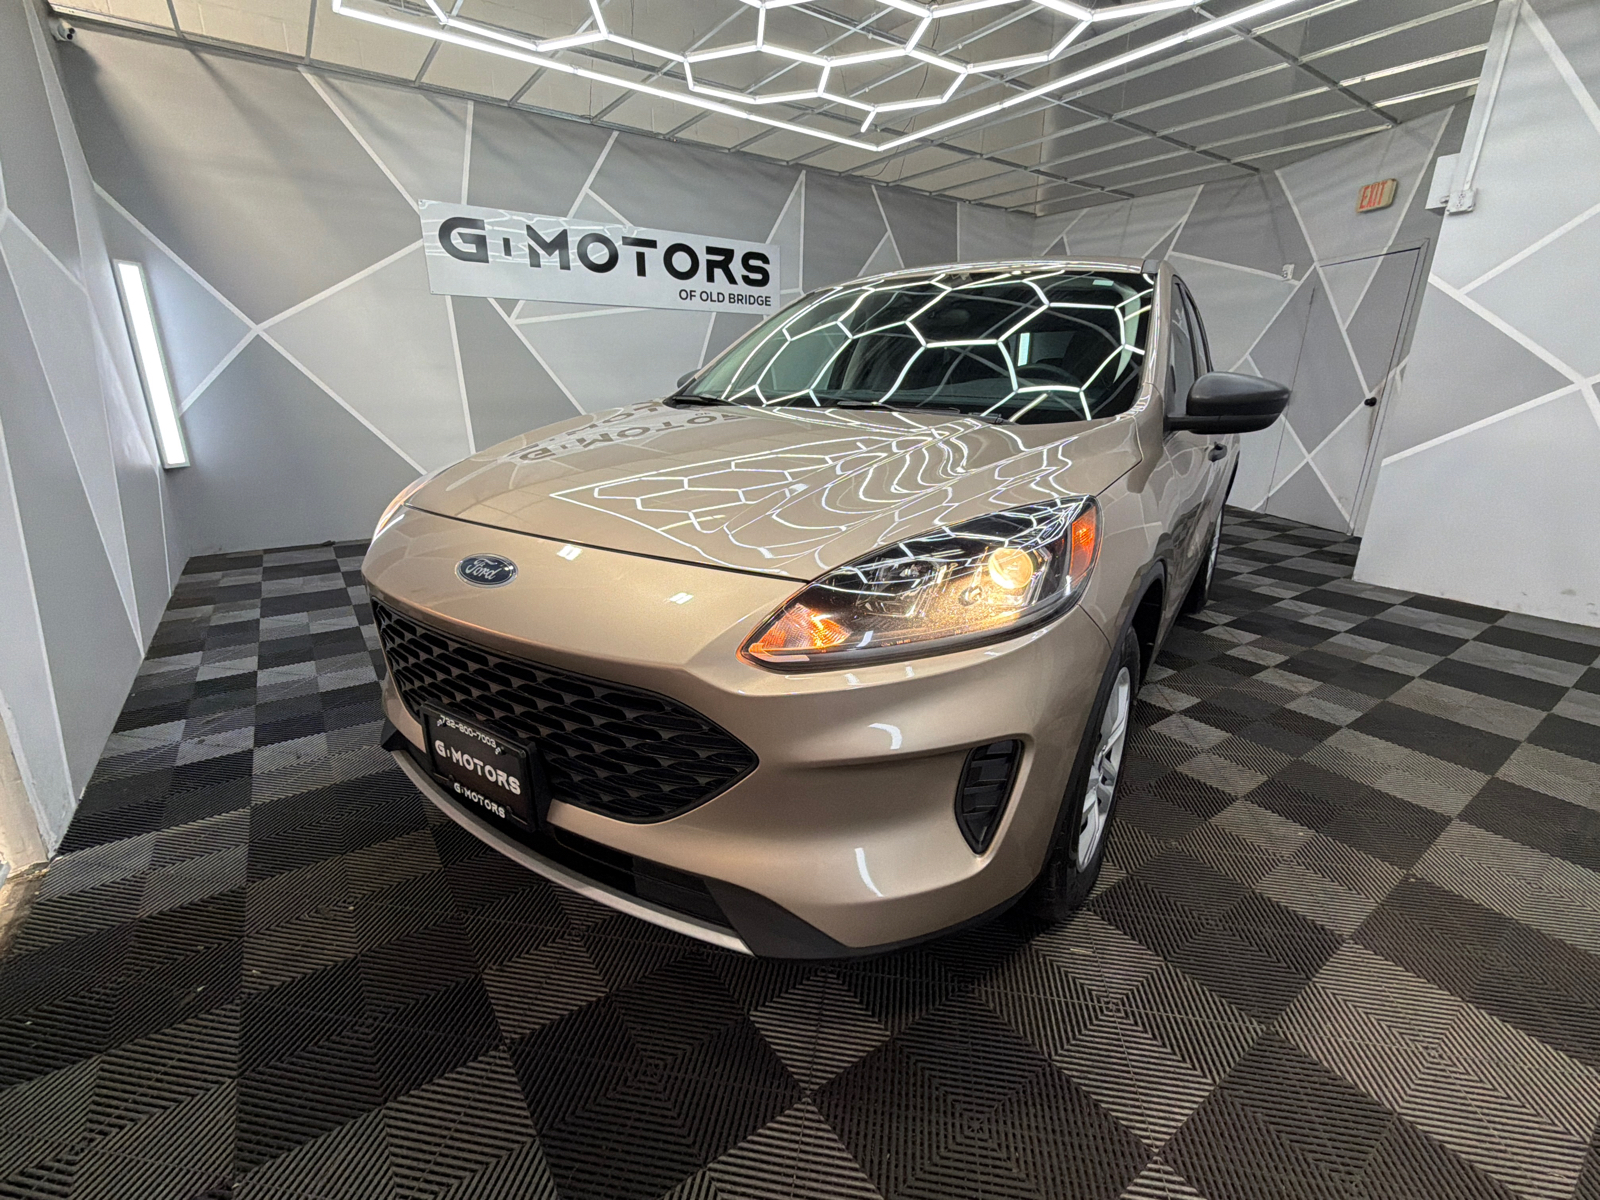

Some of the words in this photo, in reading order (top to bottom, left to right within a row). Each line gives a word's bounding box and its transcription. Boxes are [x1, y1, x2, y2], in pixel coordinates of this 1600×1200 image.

[1359, 181, 1388, 209] EXIT
[678, 288, 697, 302] OF
[699, 290, 726, 304] OLD
[727, 293, 772, 307] BRIDGE
[465, 558, 503, 580] Ford
